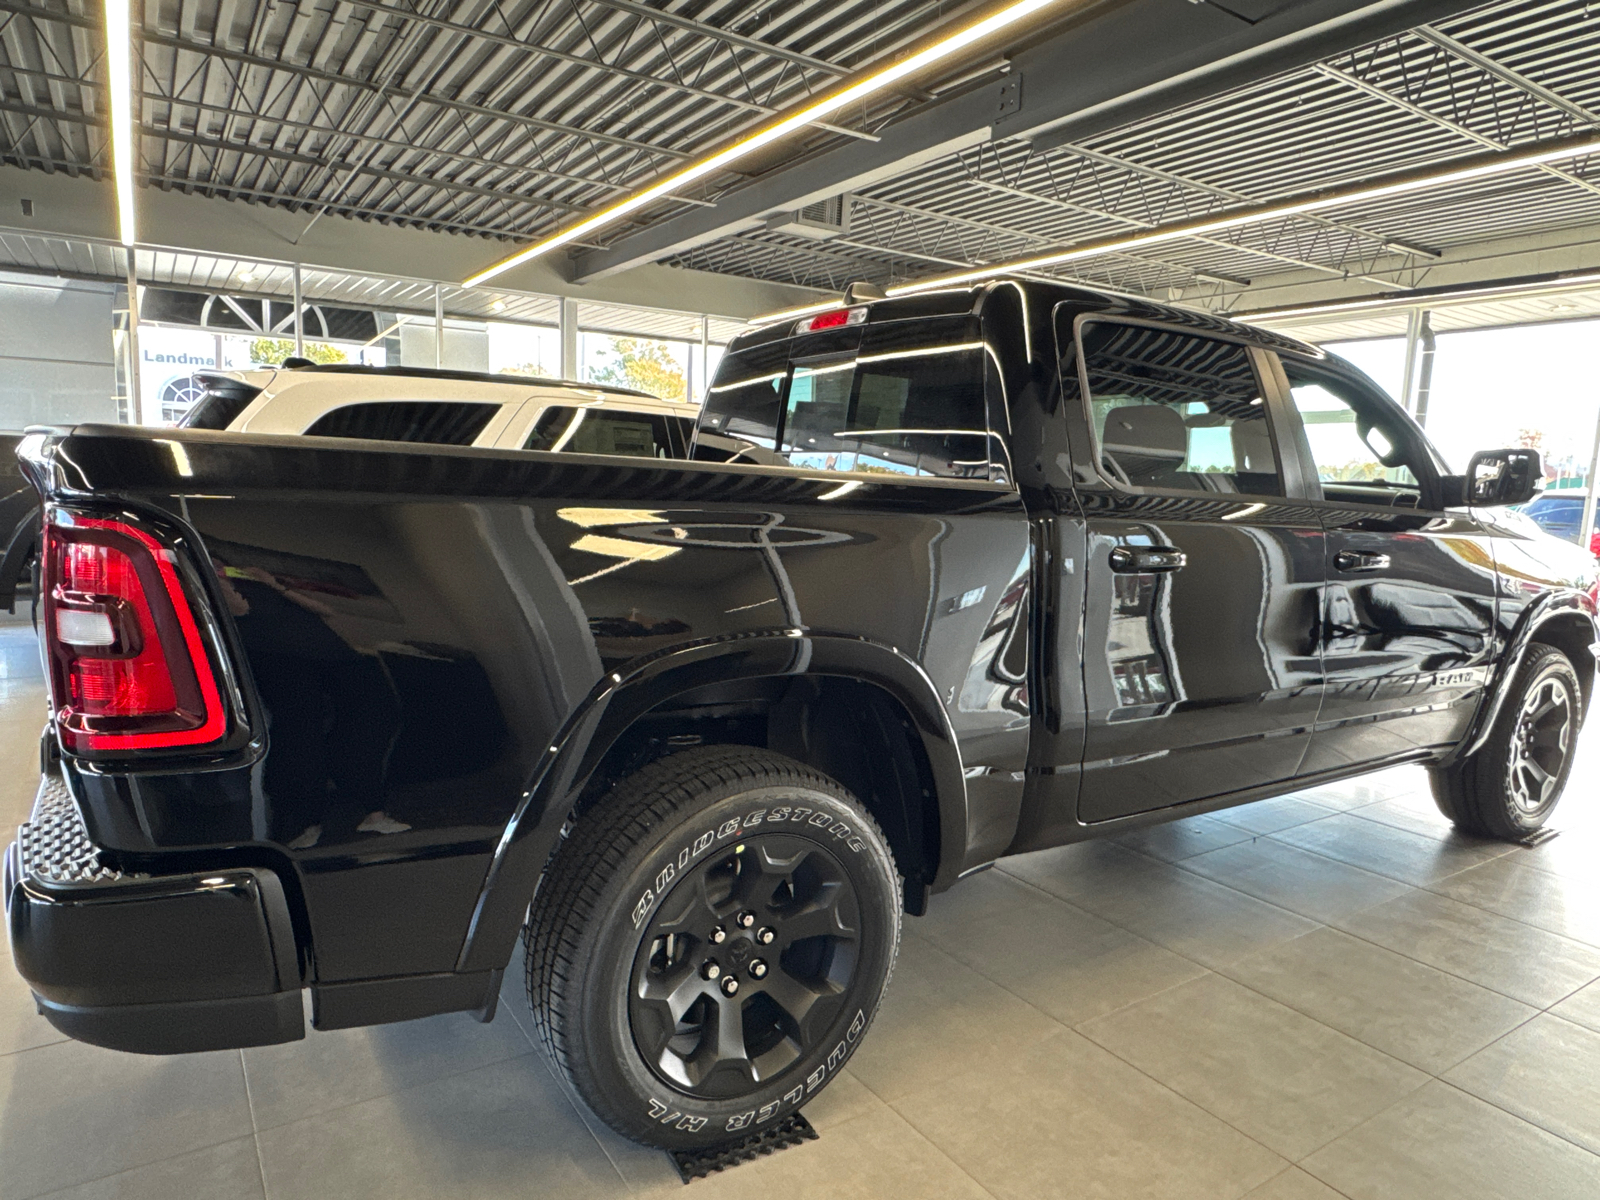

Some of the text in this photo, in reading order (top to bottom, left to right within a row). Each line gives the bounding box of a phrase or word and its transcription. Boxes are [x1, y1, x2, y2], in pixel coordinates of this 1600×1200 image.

[144, 349, 233, 368] Landmak
[631, 806, 868, 931] BRIDGESTONE
[648, 1008, 866, 1133] DUELER H/L
